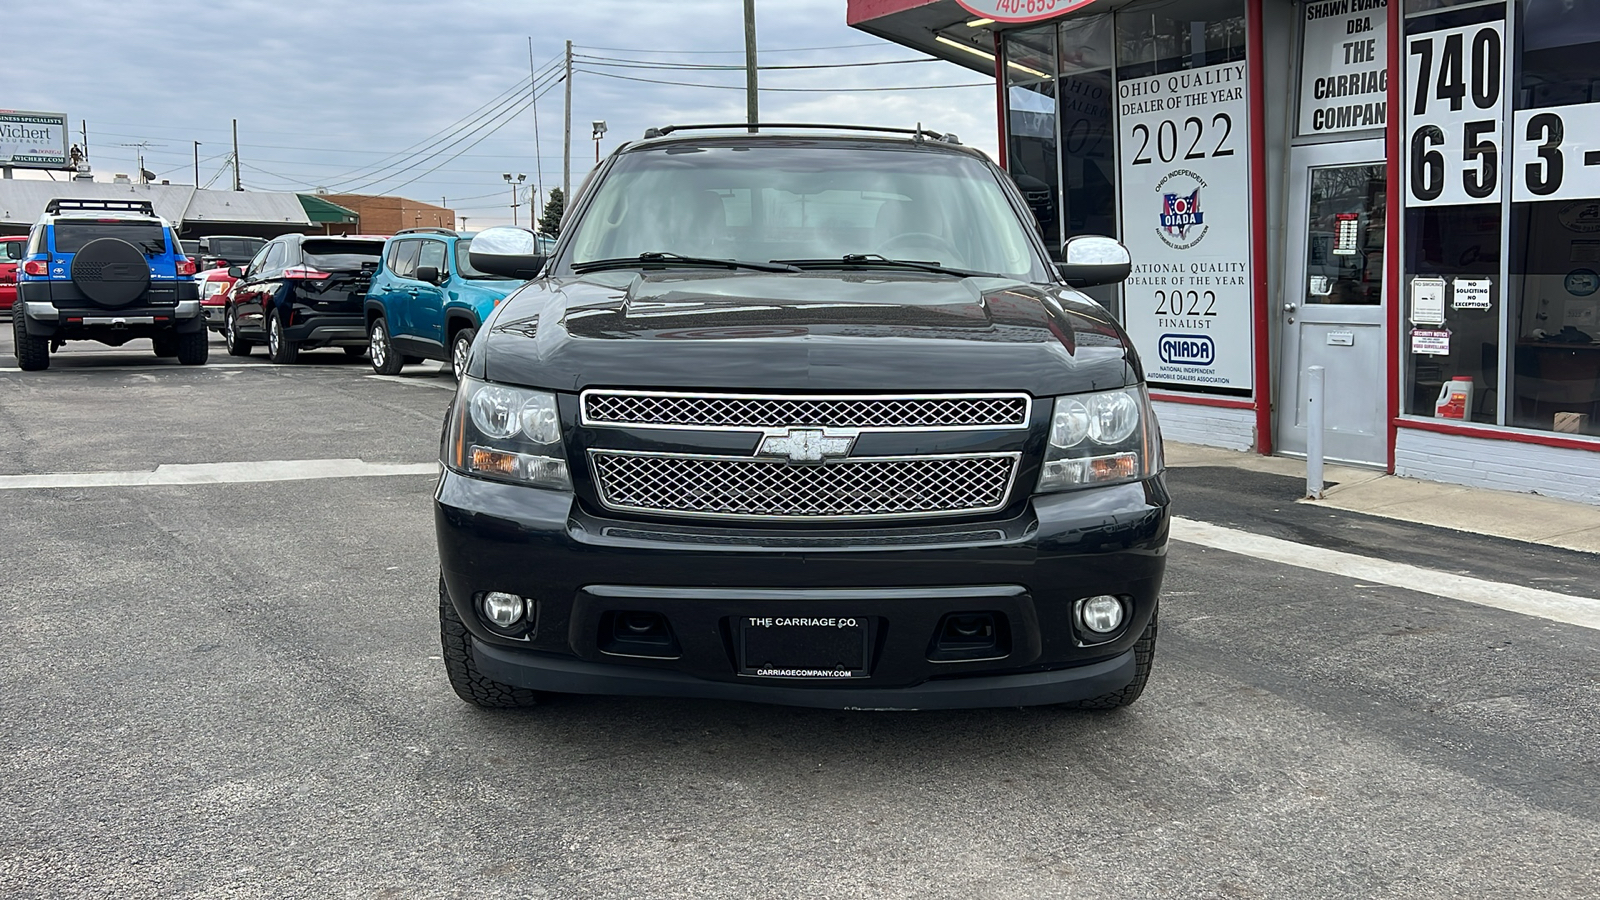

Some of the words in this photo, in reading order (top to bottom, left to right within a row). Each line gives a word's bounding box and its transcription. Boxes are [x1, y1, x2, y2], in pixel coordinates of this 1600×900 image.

[1307, 0, 1348, 20] SHAWN
[1347, 17, 1373, 34] DBA.
[1343, 39, 1375, 64] THE
[1411, 28, 1500, 115] 740
[1120, 80, 1160, 98] OHIO
[1168, 65, 1244, 93] QUALITY
[1122, 99, 1164, 116] DEALER
[1167, 96, 1182, 109] OF
[1184, 92, 1208, 107] THE
[1211, 87, 1243, 102] YEAR
[1132, 113, 1234, 165] 2022
[1155, 176, 1168, 192] OHIO
[1168, 169, 1207, 188] INDEPENDENT
[1165, 213, 1196, 225] OIADA
[1155, 228, 1173, 248] AUTOMOBILE
[1190, 225, 1209, 248] ASSOCIATION
[1190, 263, 1246, 274] QUALITY
[1128, 277, 1167, 285] DEALER
[1171, 277, 1185, 285] OF
[1189, 276, 1210, 285] THE
[1215, 276, 1245, 285] YEAR
[1155, 290, 1217, 316] 2022
[1159, 318, 1211, 328] FINALIST
[1163, 341, 1209, 360] NIADA
[1147, 372, 1176, 380] AUTOMOBILE
[1197, 375, 1230, 384] ASSOCIATION
[749, 618, 772, 626] THE
[775, 618, 836, 626] CARRIAGE
[839, 618, 858, 626] CO.
[757, 669, 851, 677] CARRIAGECOMPANY.COM
